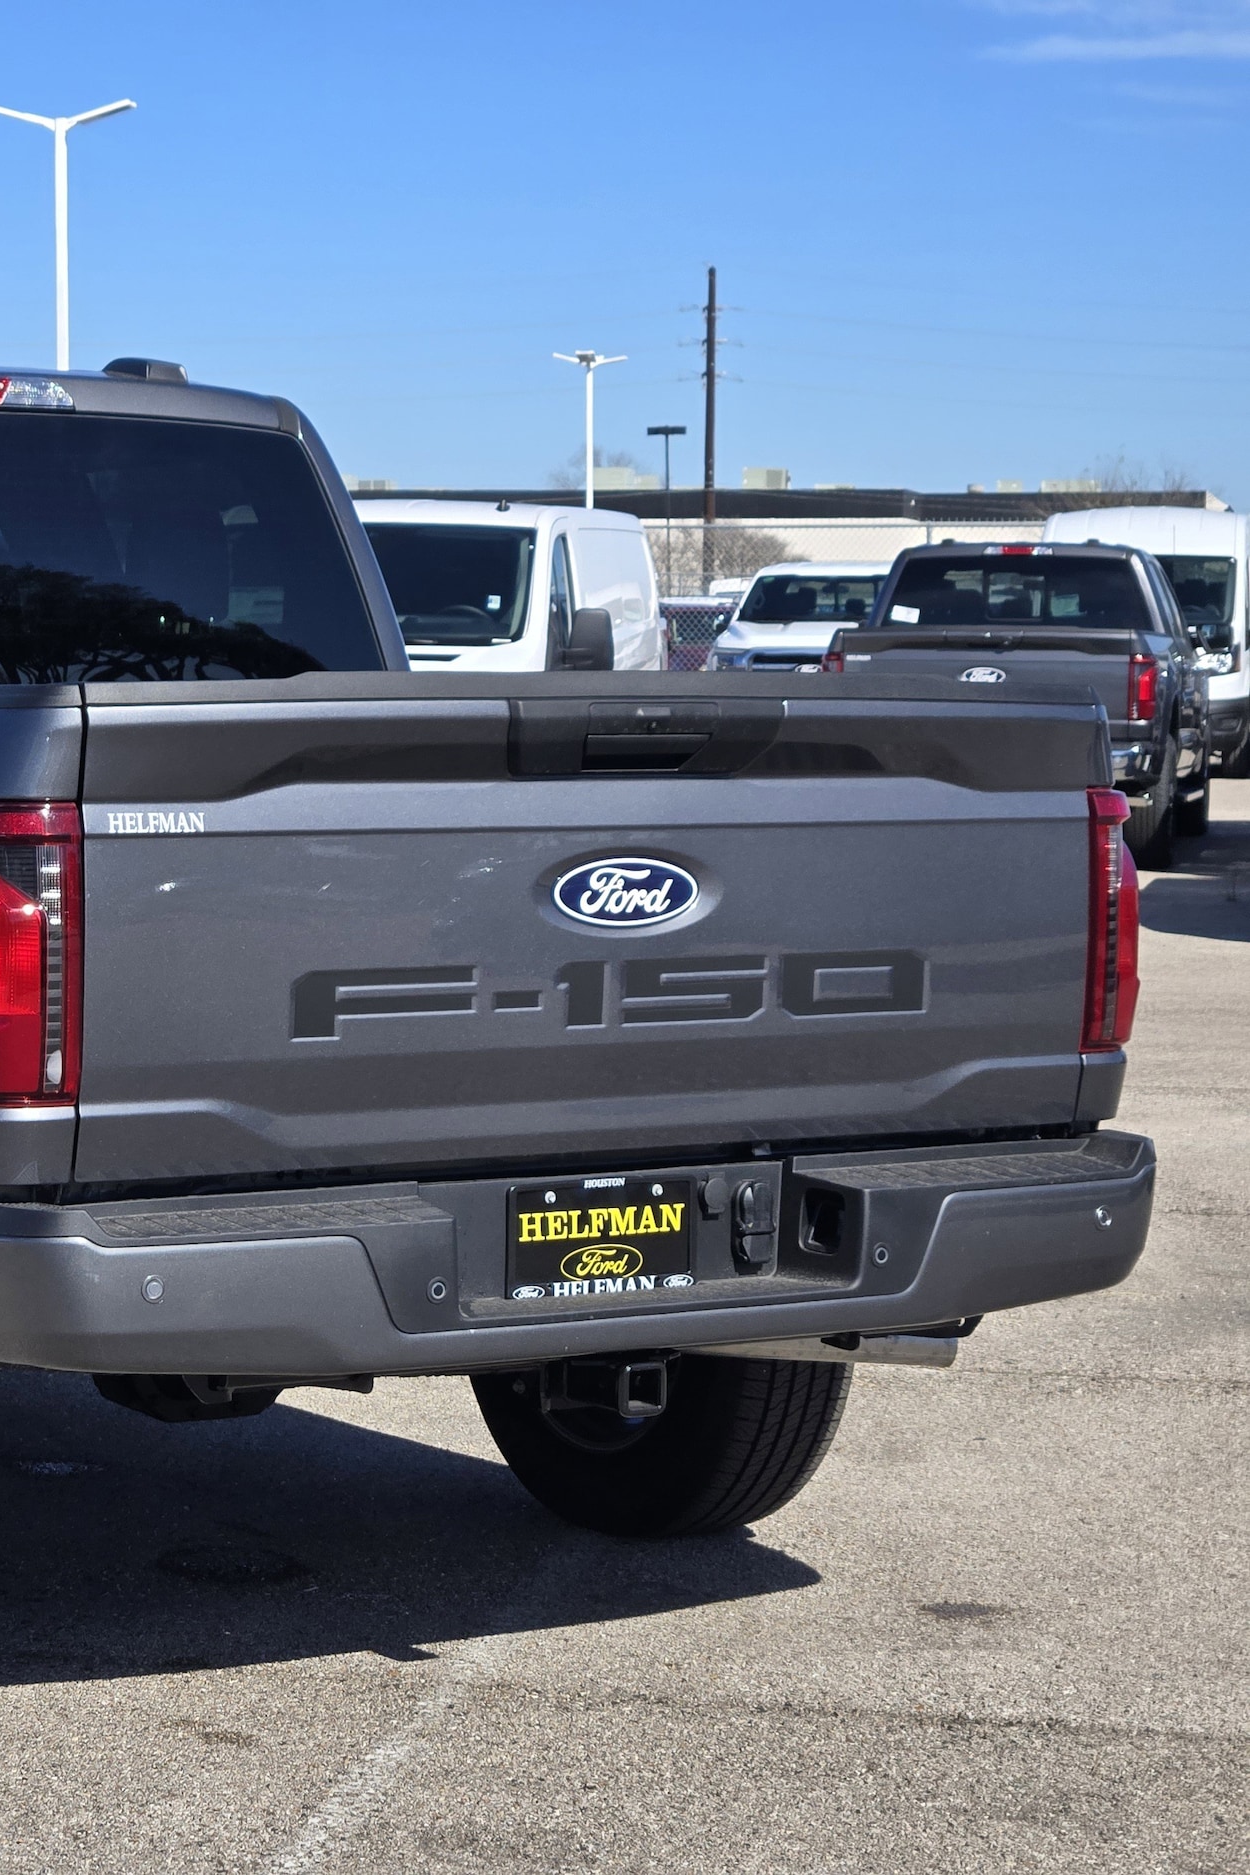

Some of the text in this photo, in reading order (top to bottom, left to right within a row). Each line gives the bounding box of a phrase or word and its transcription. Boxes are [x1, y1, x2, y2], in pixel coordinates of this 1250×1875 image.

[107, 811, 205, 834] HELFMAN
[578, 866, 674, 915] Ford
[289, 948, 929, 1043] F-150
[584, 1177, 626, 1189] HOUSTON
[518, 1203, 686, 1243] HELFMAN
[575, 1249, 630, 1277] Ford
